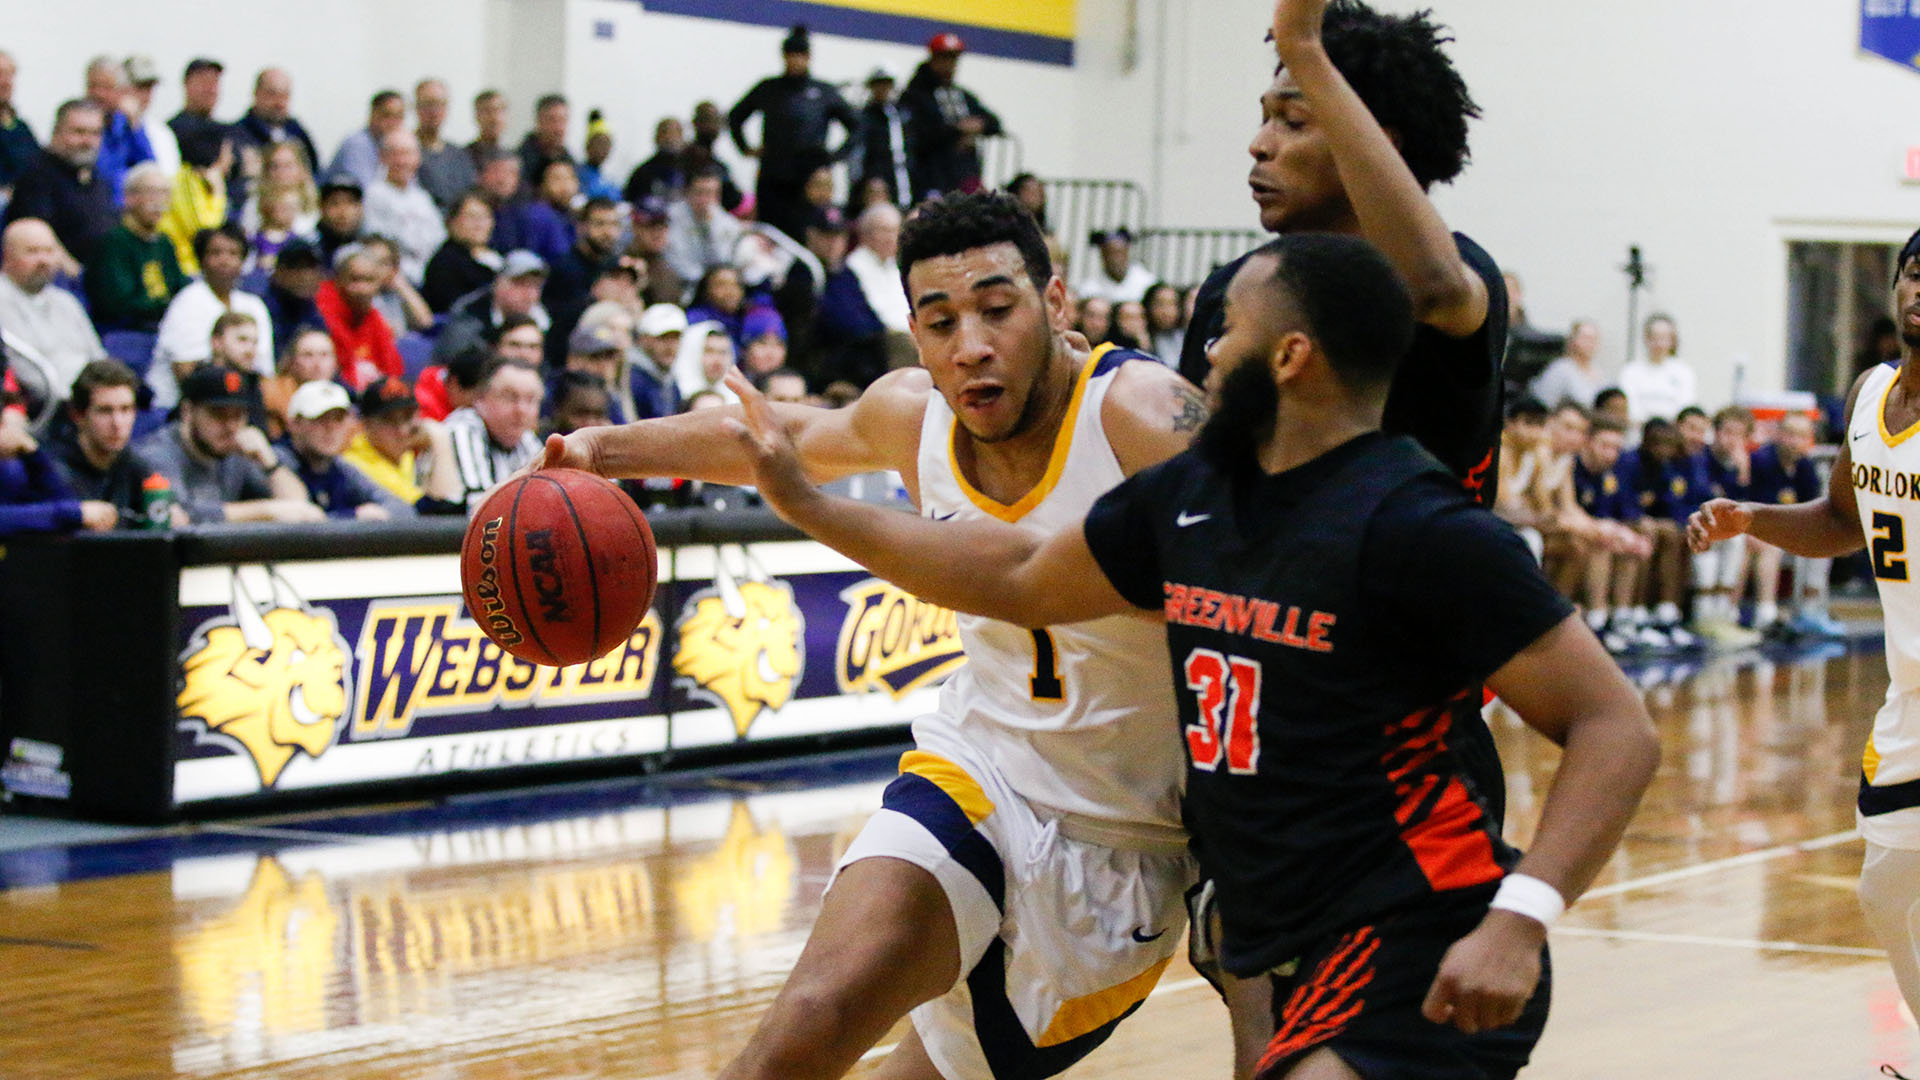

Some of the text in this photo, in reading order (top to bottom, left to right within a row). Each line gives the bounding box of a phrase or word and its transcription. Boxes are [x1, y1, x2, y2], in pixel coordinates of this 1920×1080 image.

[477, 517, 525, 647] Wilson
[525, 528, 574, 623] NCAA
[1871, 509, 1911, 583] 2
[1027, 626, 1068, 703] 1
[414, 726, 628, 776] ATHLETICS
[1184, 647, 1262, 776] 31
